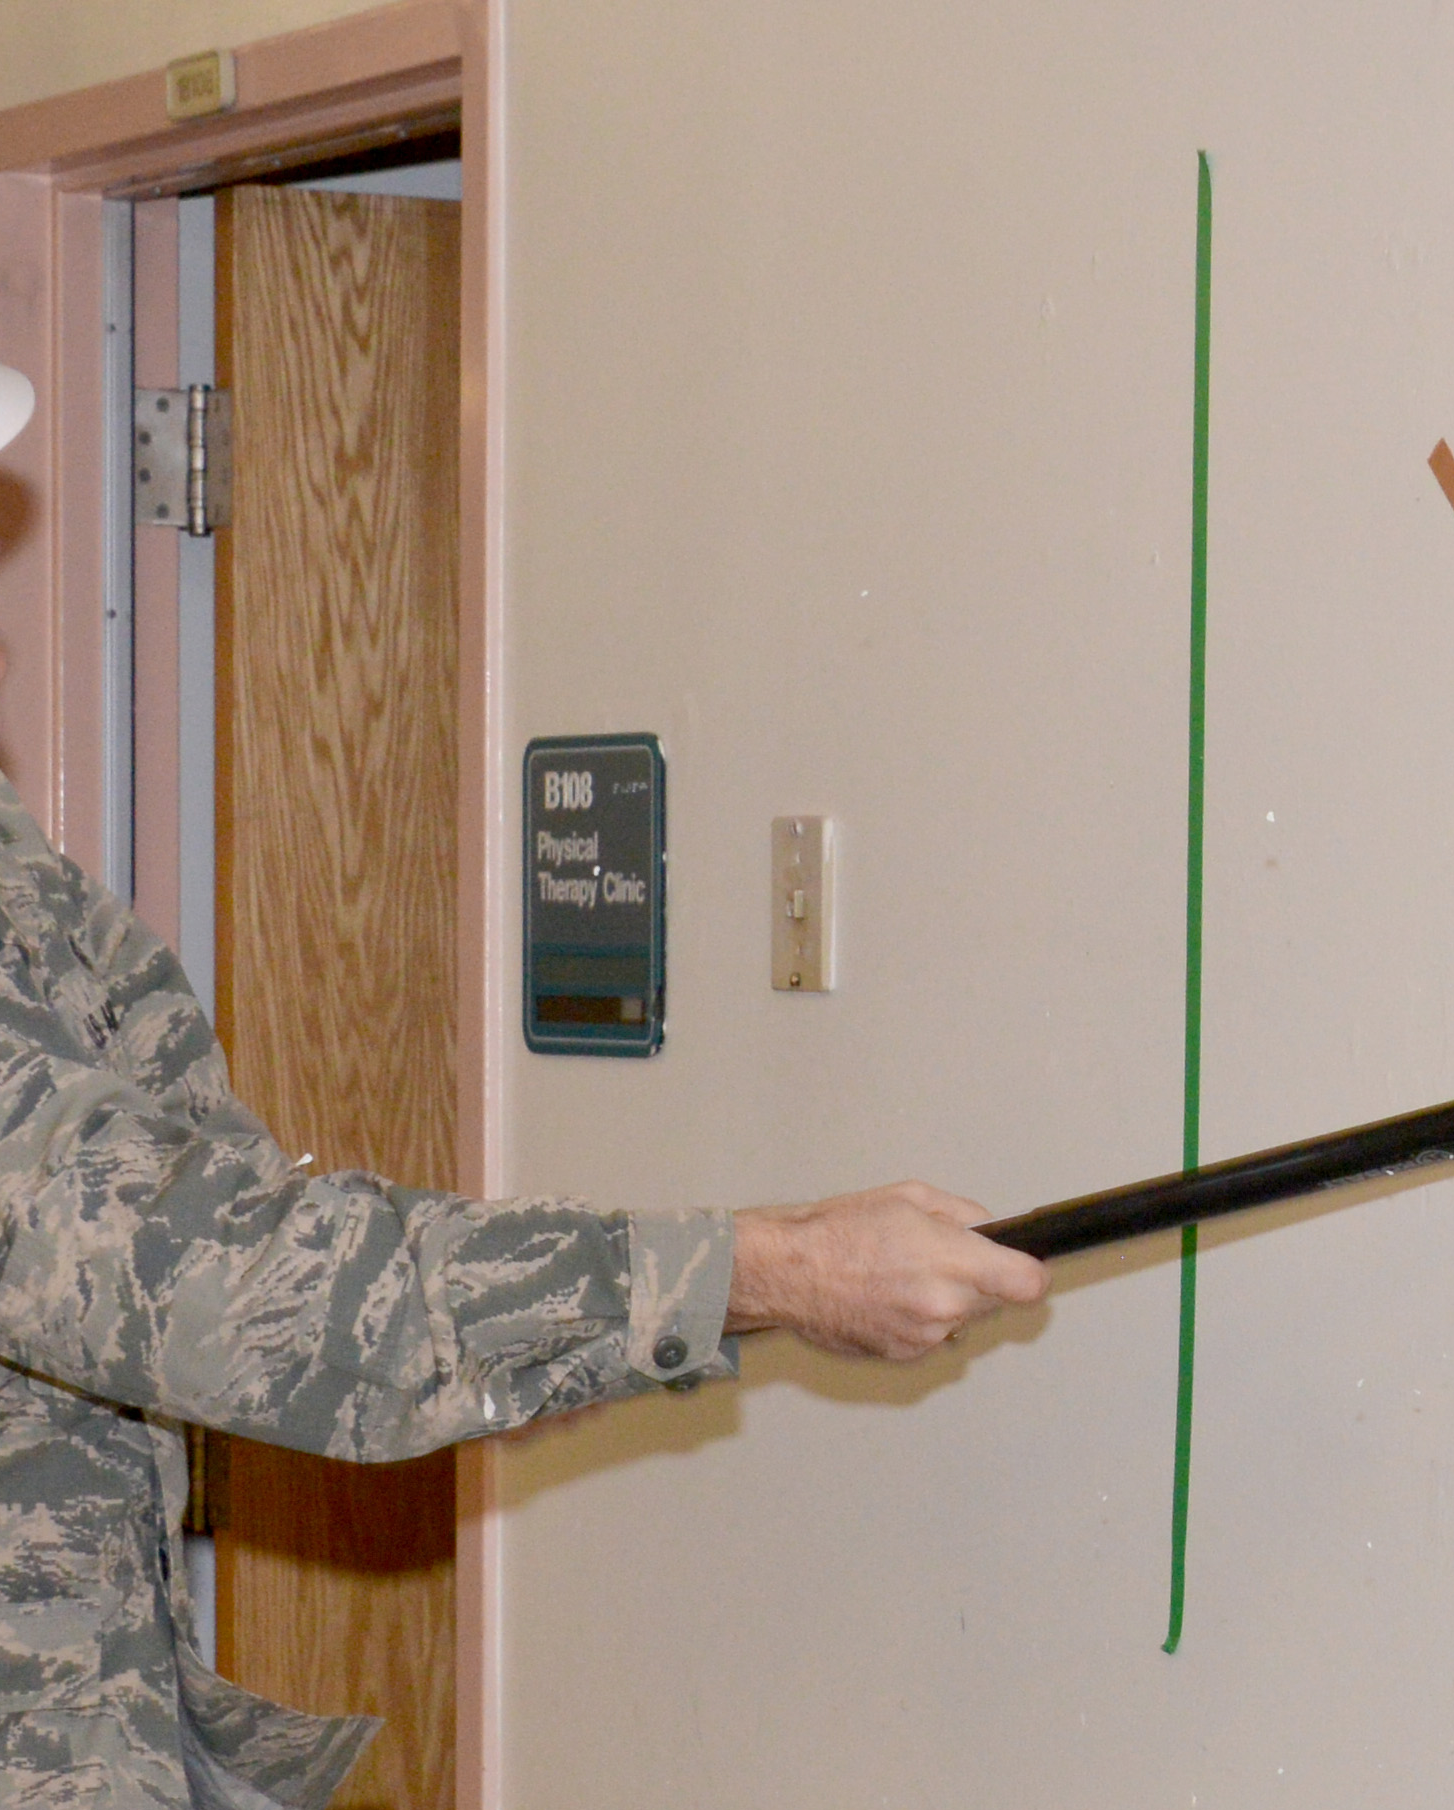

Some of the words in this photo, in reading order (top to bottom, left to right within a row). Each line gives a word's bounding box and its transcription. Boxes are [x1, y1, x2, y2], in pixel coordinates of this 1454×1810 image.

[544, 771, 593, 810] B108
[537, 830, 598, 866] Physical
[537, 872, 598, 908] Therapy
[603, 871, 646, 904] Clinic
